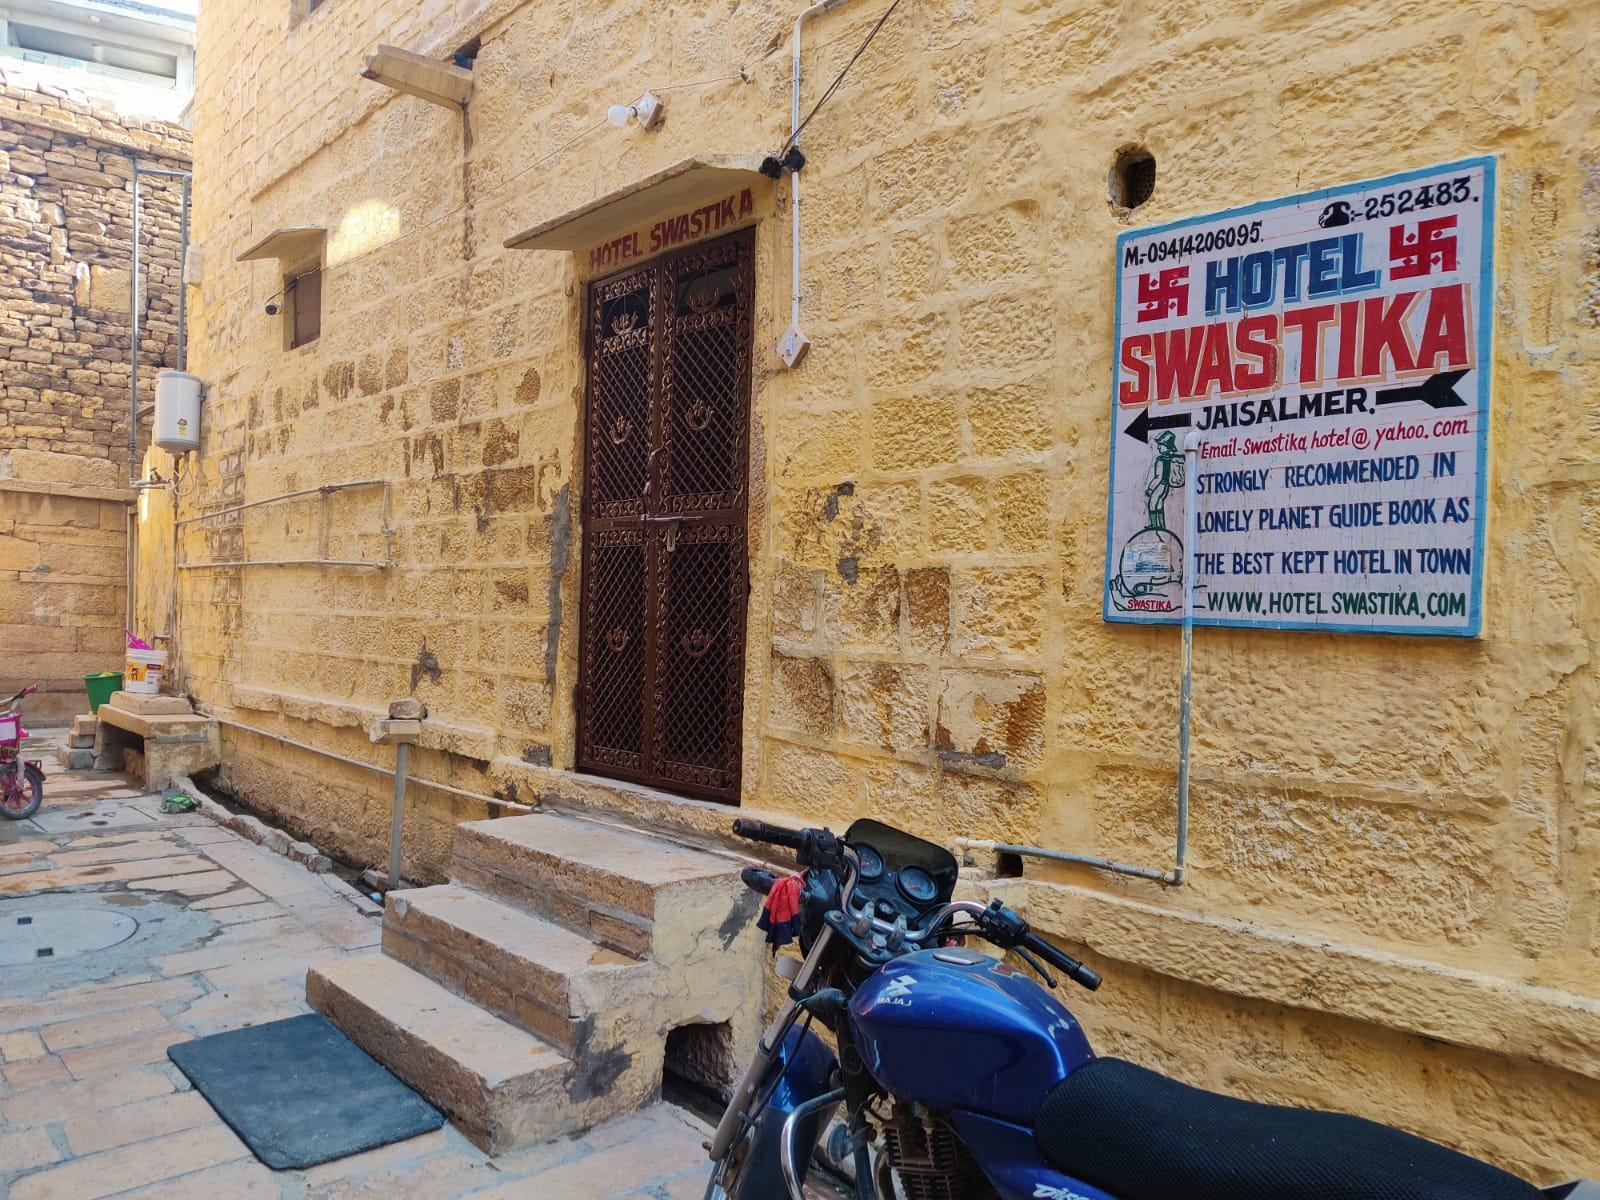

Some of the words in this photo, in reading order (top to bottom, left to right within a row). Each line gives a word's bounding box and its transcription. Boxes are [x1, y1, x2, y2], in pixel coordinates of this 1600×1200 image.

[589, 231, 643, 272] HOTEL
[650, 188, 753, 253] SWASTIKA
[1205, 232, 1381, 316] HOTEL
[1119, 283, 1475, 407] SWASTIKA
[1196, 388, 1375, 431] JAISALMER.
[1196, 468, 1270, 495] STRONGLY
[1285, 454, 1419, 489] RECOMMENDED
[1433, 451, 1456, 478] IN
[1197, 509, 1253, 533] LONELY
[1259, 505, 1322, 530] PLANET
[1329, 502, 1383, 529] GUIDE
[1388, 499, 1437, 526] BOOK
[1443, 496, 1470, 524] AS
[1194, 552, 1225, 575] THE
[1232, 550, 1274, 575] BEST
[1281, 549, 1329, 575] KEPT
[1334, 549, 1392, 574] HOTEL
[1394, 549, 1412, 574] IN
[1416, 548, 1471, 576] TOWN
[1127, 599, 1172, 610] SWASTIKA
